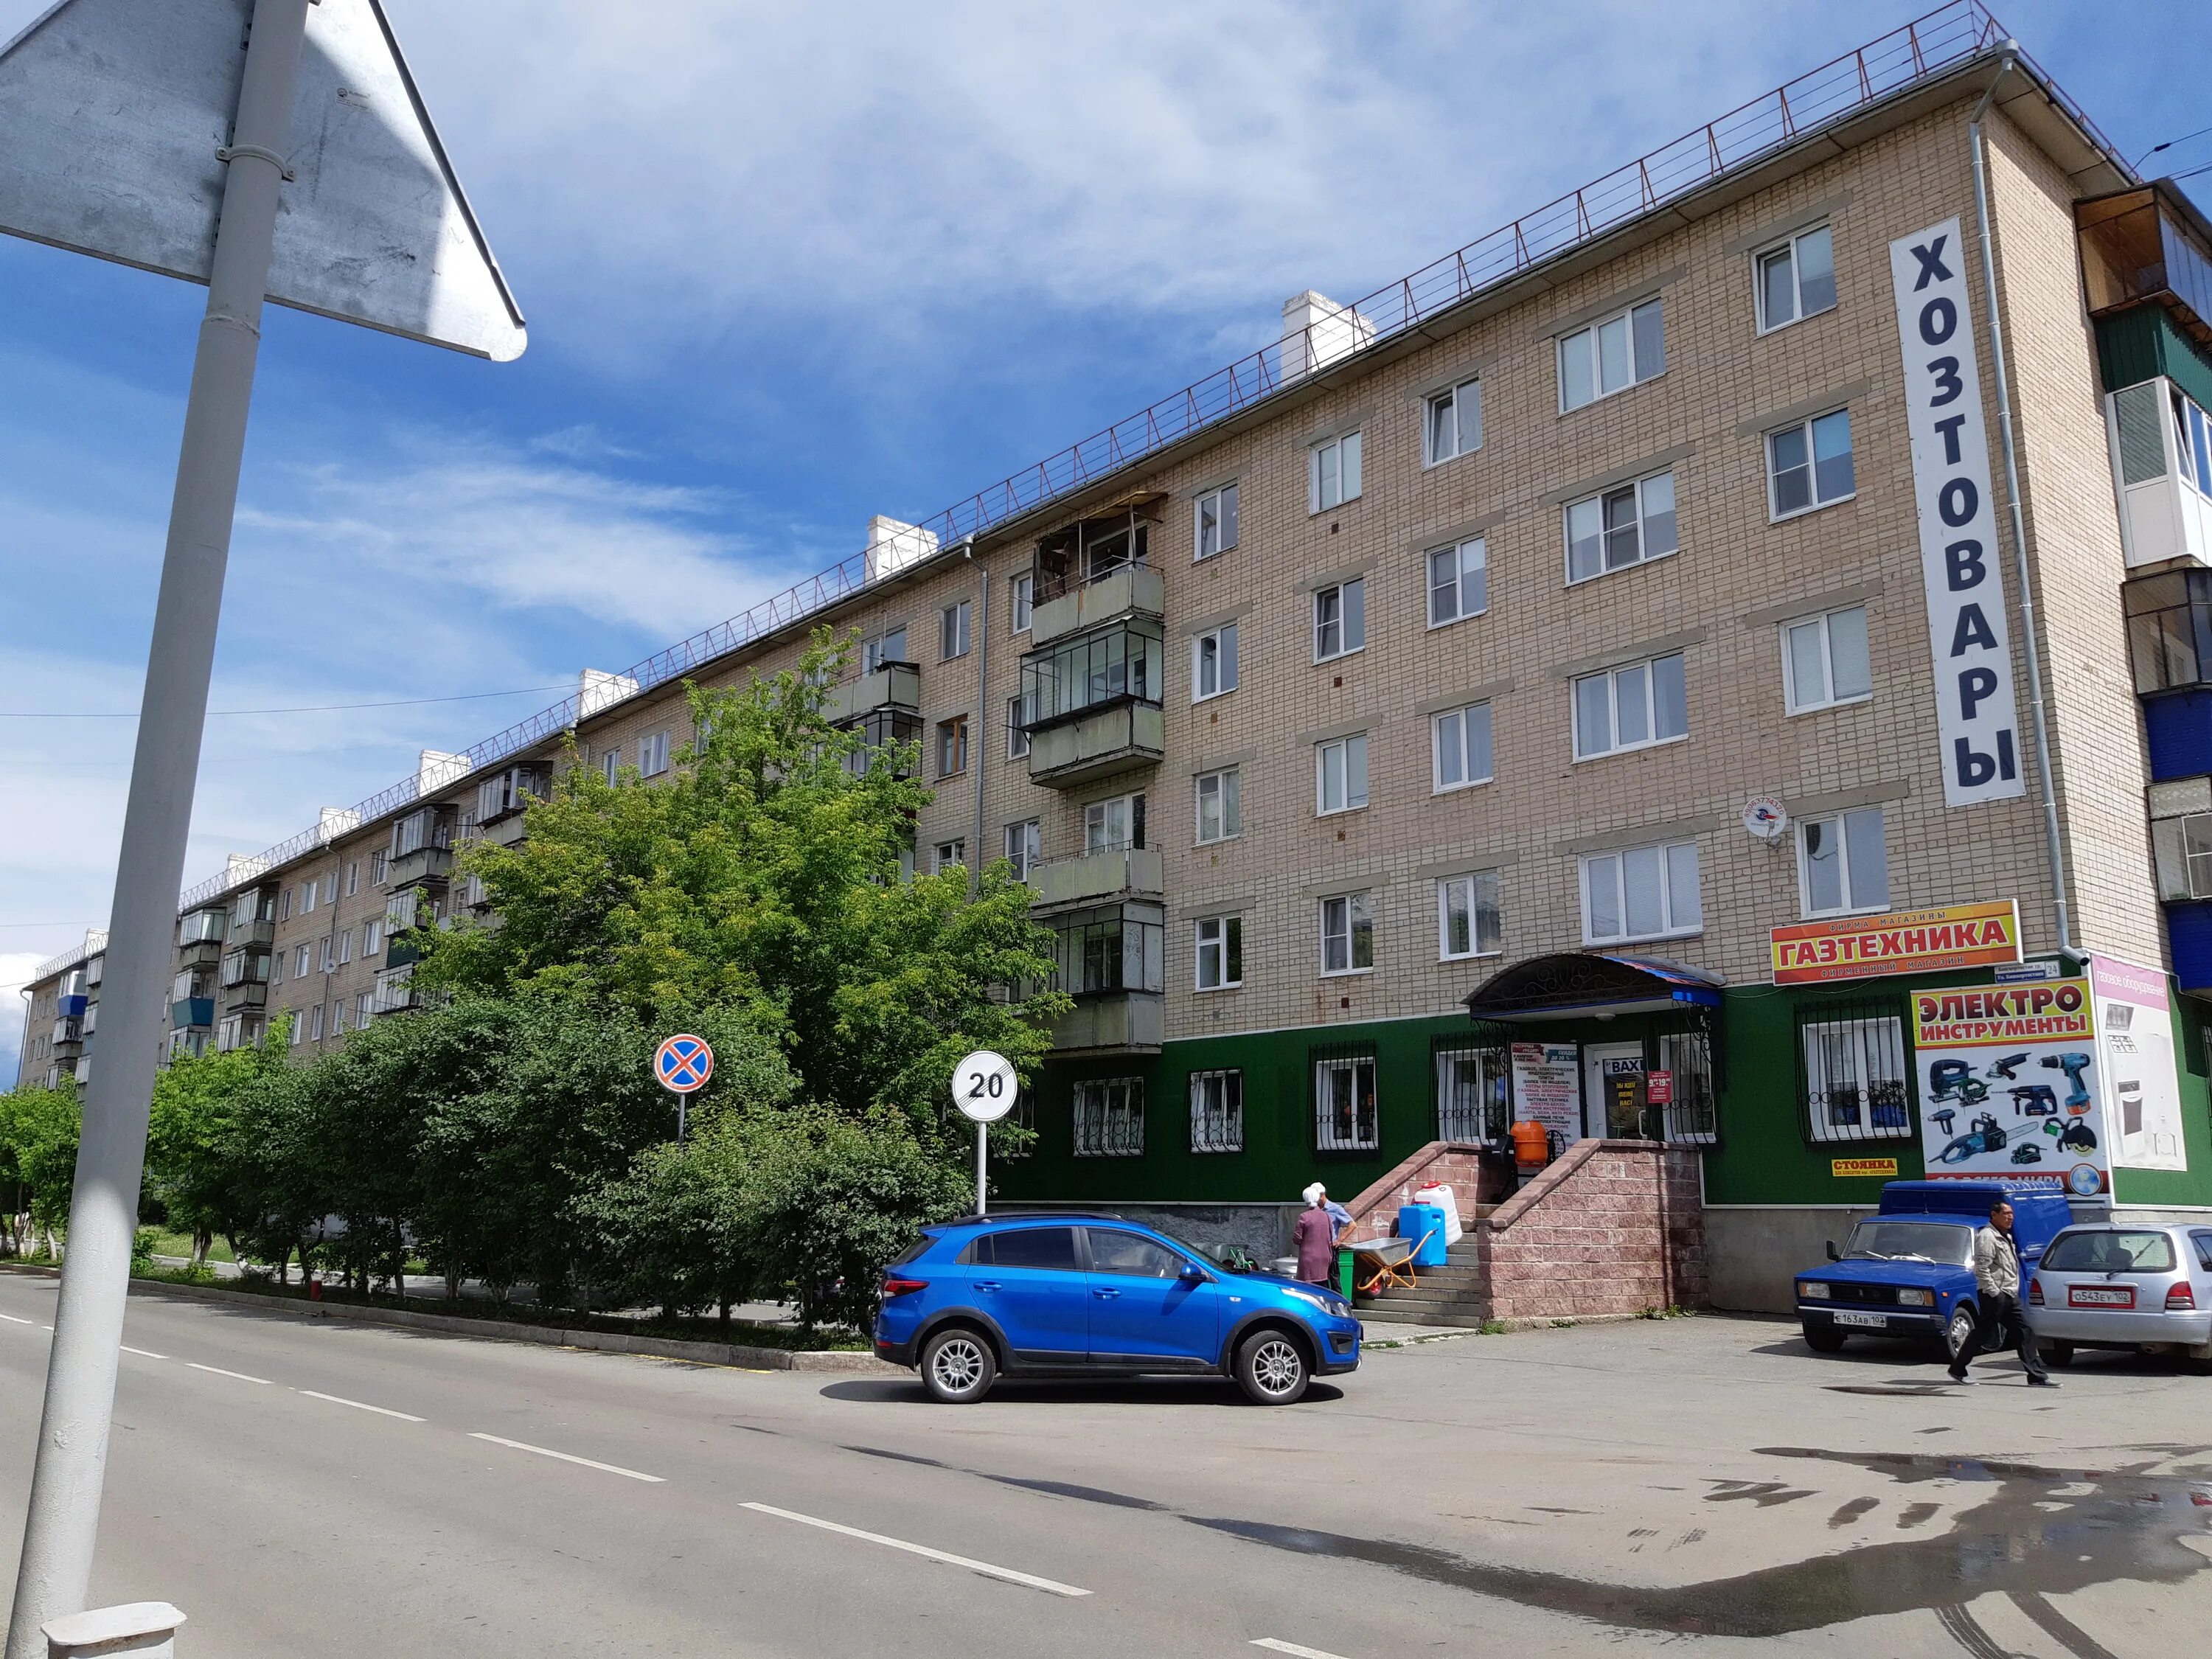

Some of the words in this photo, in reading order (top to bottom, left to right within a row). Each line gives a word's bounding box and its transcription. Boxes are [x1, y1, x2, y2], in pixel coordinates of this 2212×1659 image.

[1910, 234, 2017, 787] ХОЗТОВАРЫ
[1829, 920, 1868, 932] ФИРМА
[1880, 911, 1946, 925] МАГАЗИНЫ
[1779, 919, 2008, 966] ГАЗТЕХНИКА
[1821, 962, 1896, 978] ФИРМЕННЫЙ
[1907, 956, 1964, 969] МАГАЗИН
[2047, 965, 2058, 974] 24
[2122, 975, 2166, 997] оборудование
[1919, 985, 2082, 1023] ЭЛЕКТРО
[1921, 1015, 2087, 1041] ИНСТРУМЕНТЫ
[969, 1072, 1004, 1098] 20
[1834, 1160, 1896, 1169] СТОЯНКА
[1836, 1314, 1868, 1324] Е163АВ
